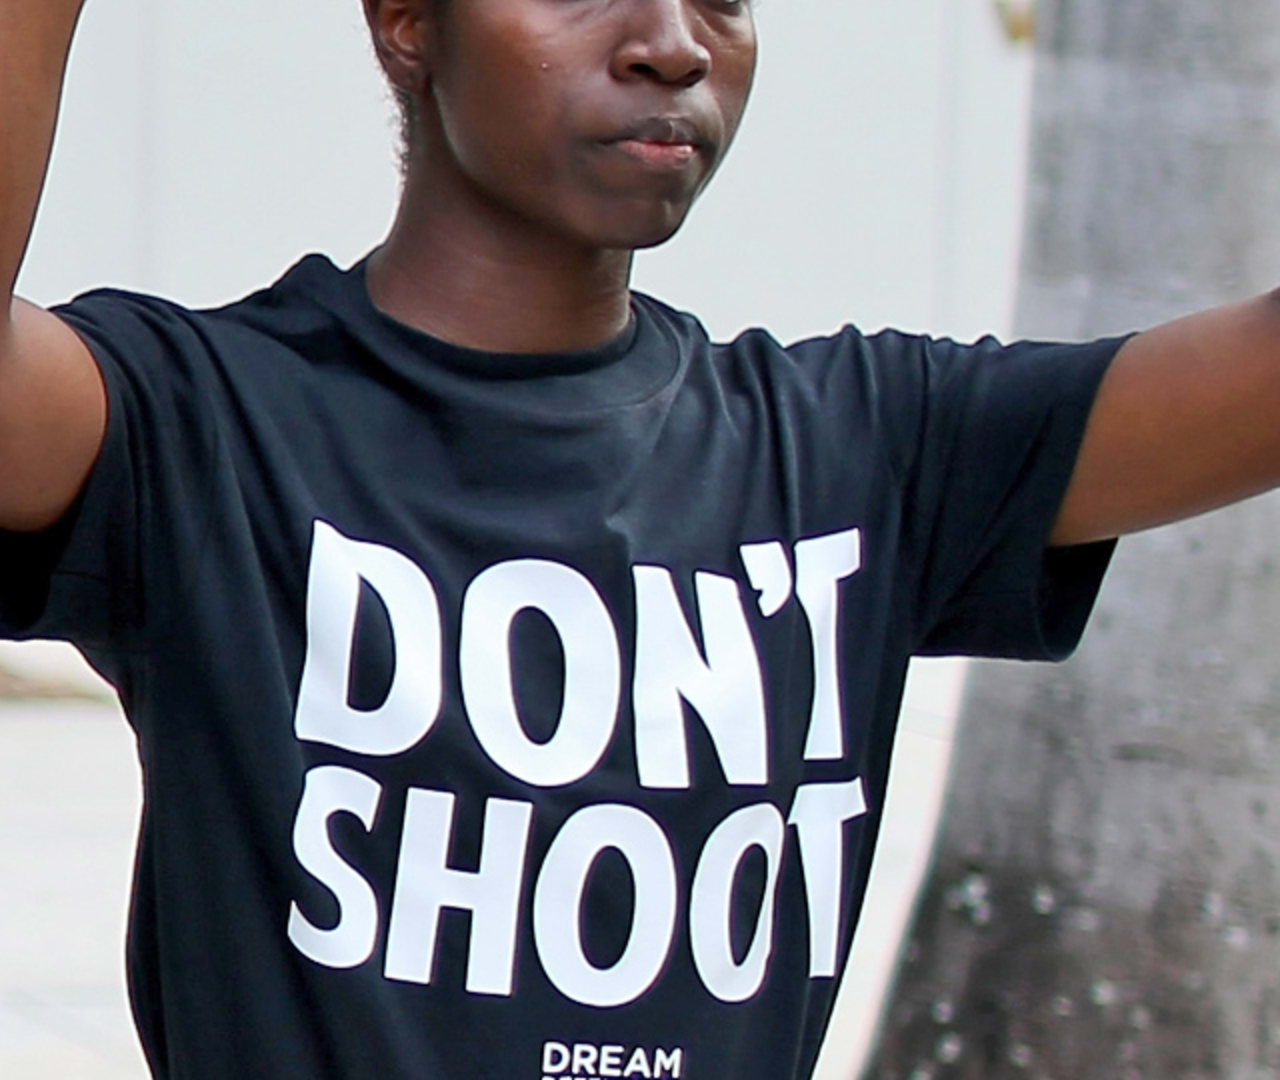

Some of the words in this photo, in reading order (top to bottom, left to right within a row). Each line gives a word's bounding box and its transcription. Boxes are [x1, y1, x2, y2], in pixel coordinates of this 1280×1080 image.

[294, 518, 861, 788] DON'T
[286, 777, 868, 1008] SHOOT
[541, 1040, 683, 1079] DREAM
